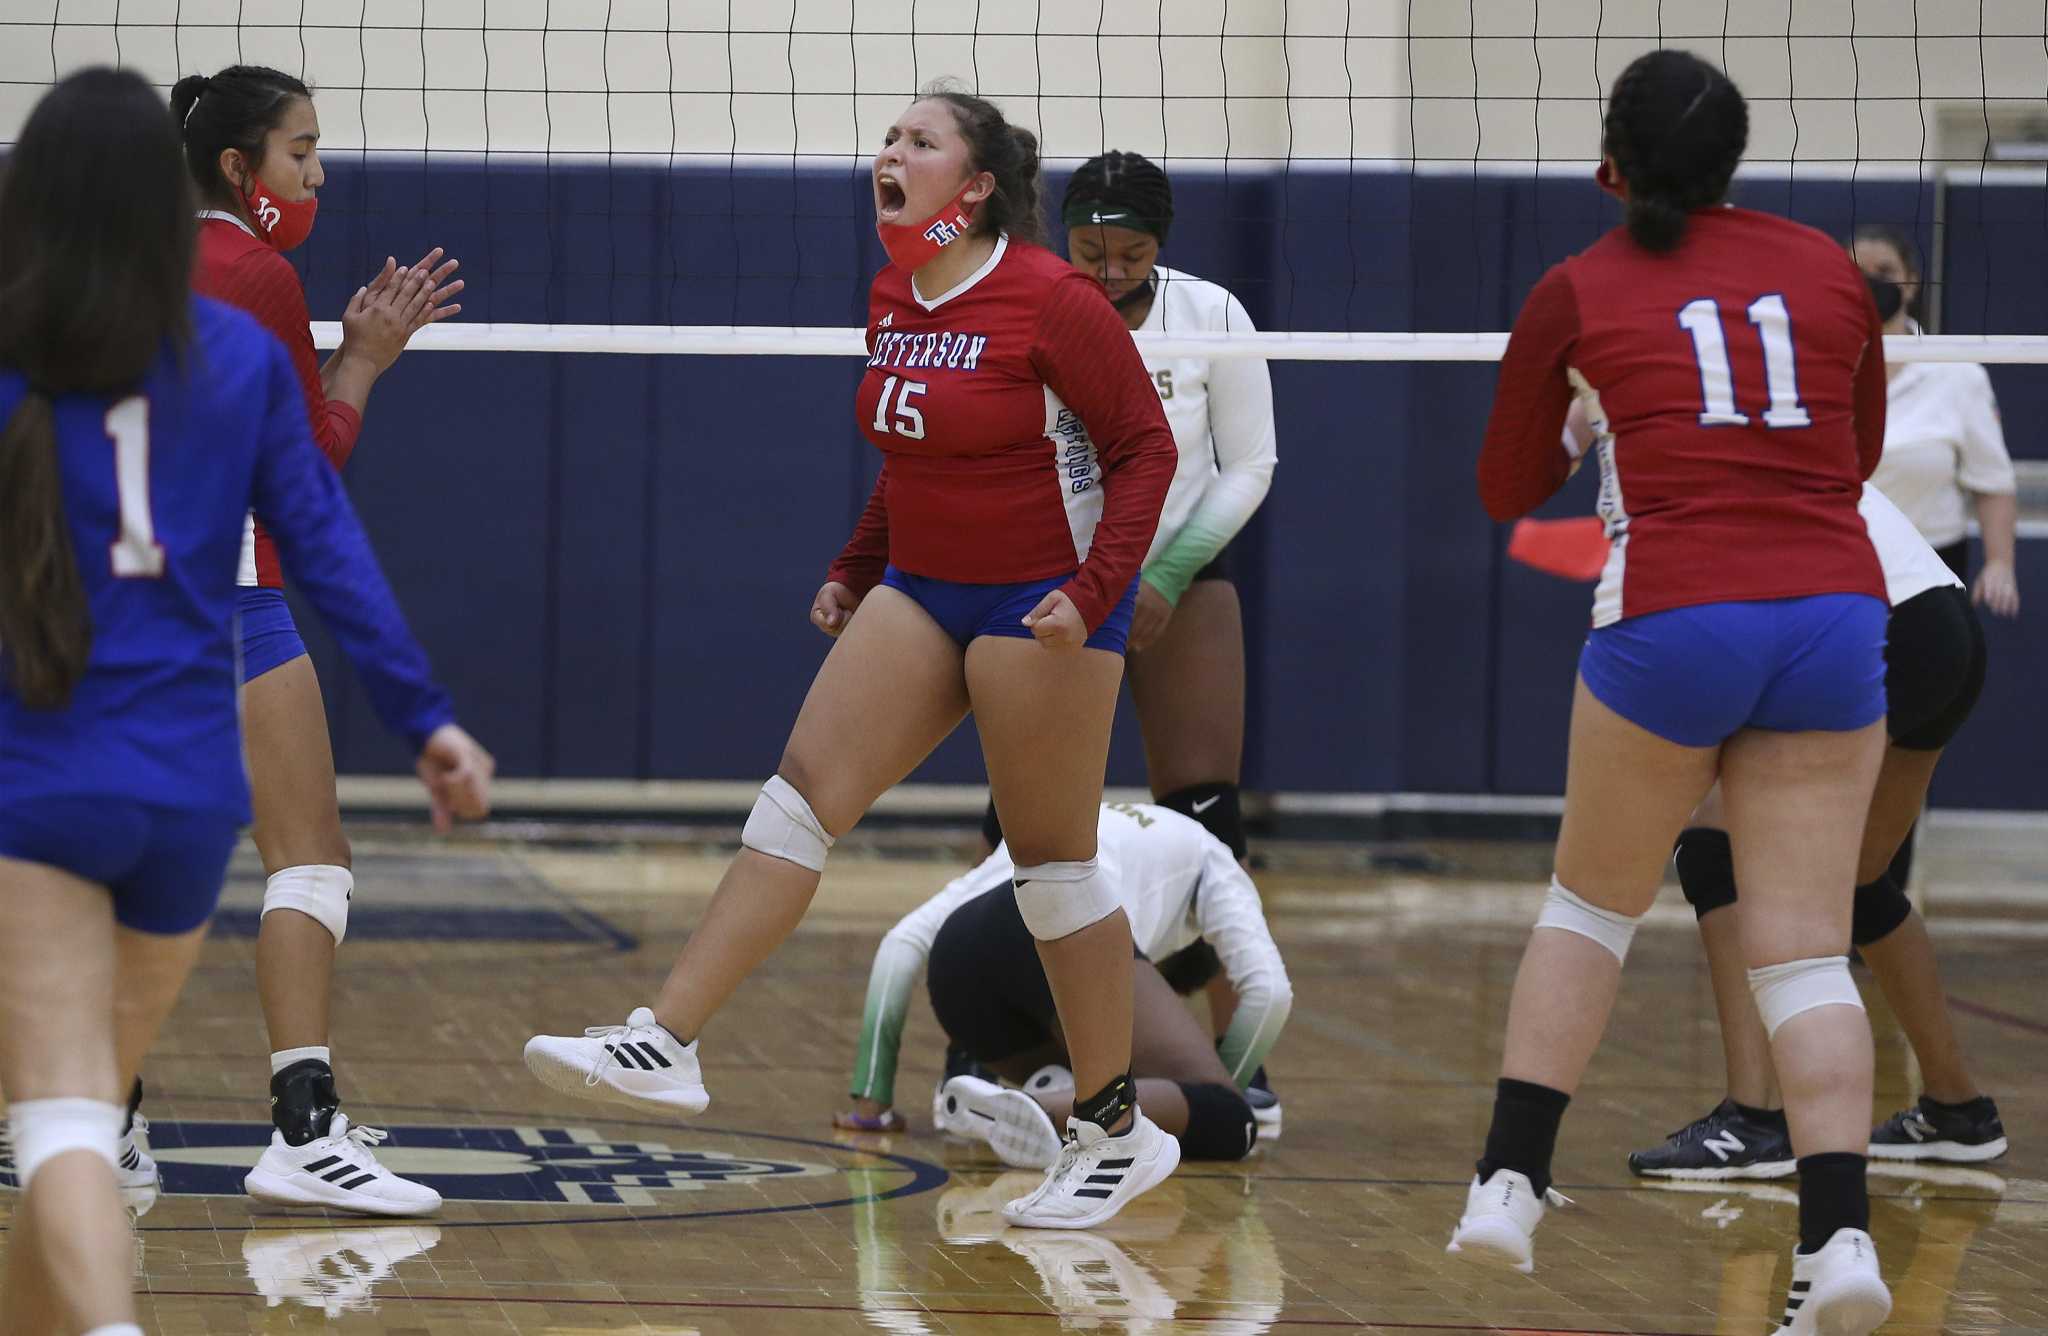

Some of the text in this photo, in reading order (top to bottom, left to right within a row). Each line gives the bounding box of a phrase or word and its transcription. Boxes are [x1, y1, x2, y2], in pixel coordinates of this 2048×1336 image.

[873, 375, 928, 440] 15
[1676, 290, 1813, 428] 11
[104, 395, 166, 580] 1
